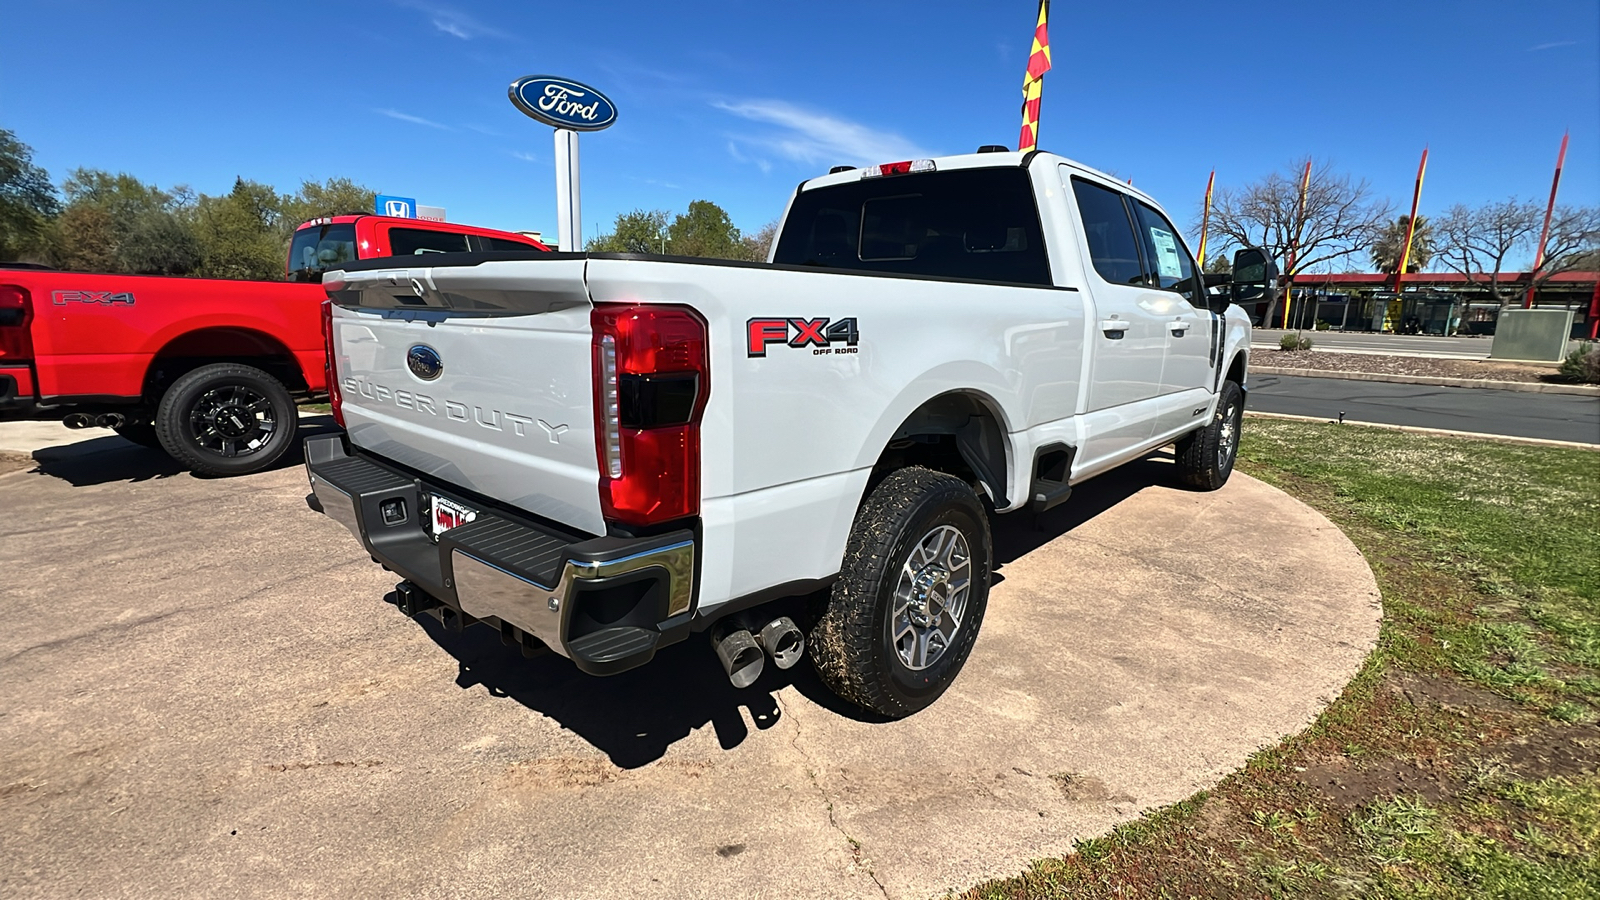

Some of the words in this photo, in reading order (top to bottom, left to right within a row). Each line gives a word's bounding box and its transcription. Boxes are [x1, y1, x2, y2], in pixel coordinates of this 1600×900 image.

[538, 84, 599, 120] Ford
[52, 290, 136, 306] FX4
[746, 317, 859, 358] FX4
[834, 347, 858, 355] ROAD
[343, 377, 437, 416] SUPER
[446, 400, 569, 445] DUTY
